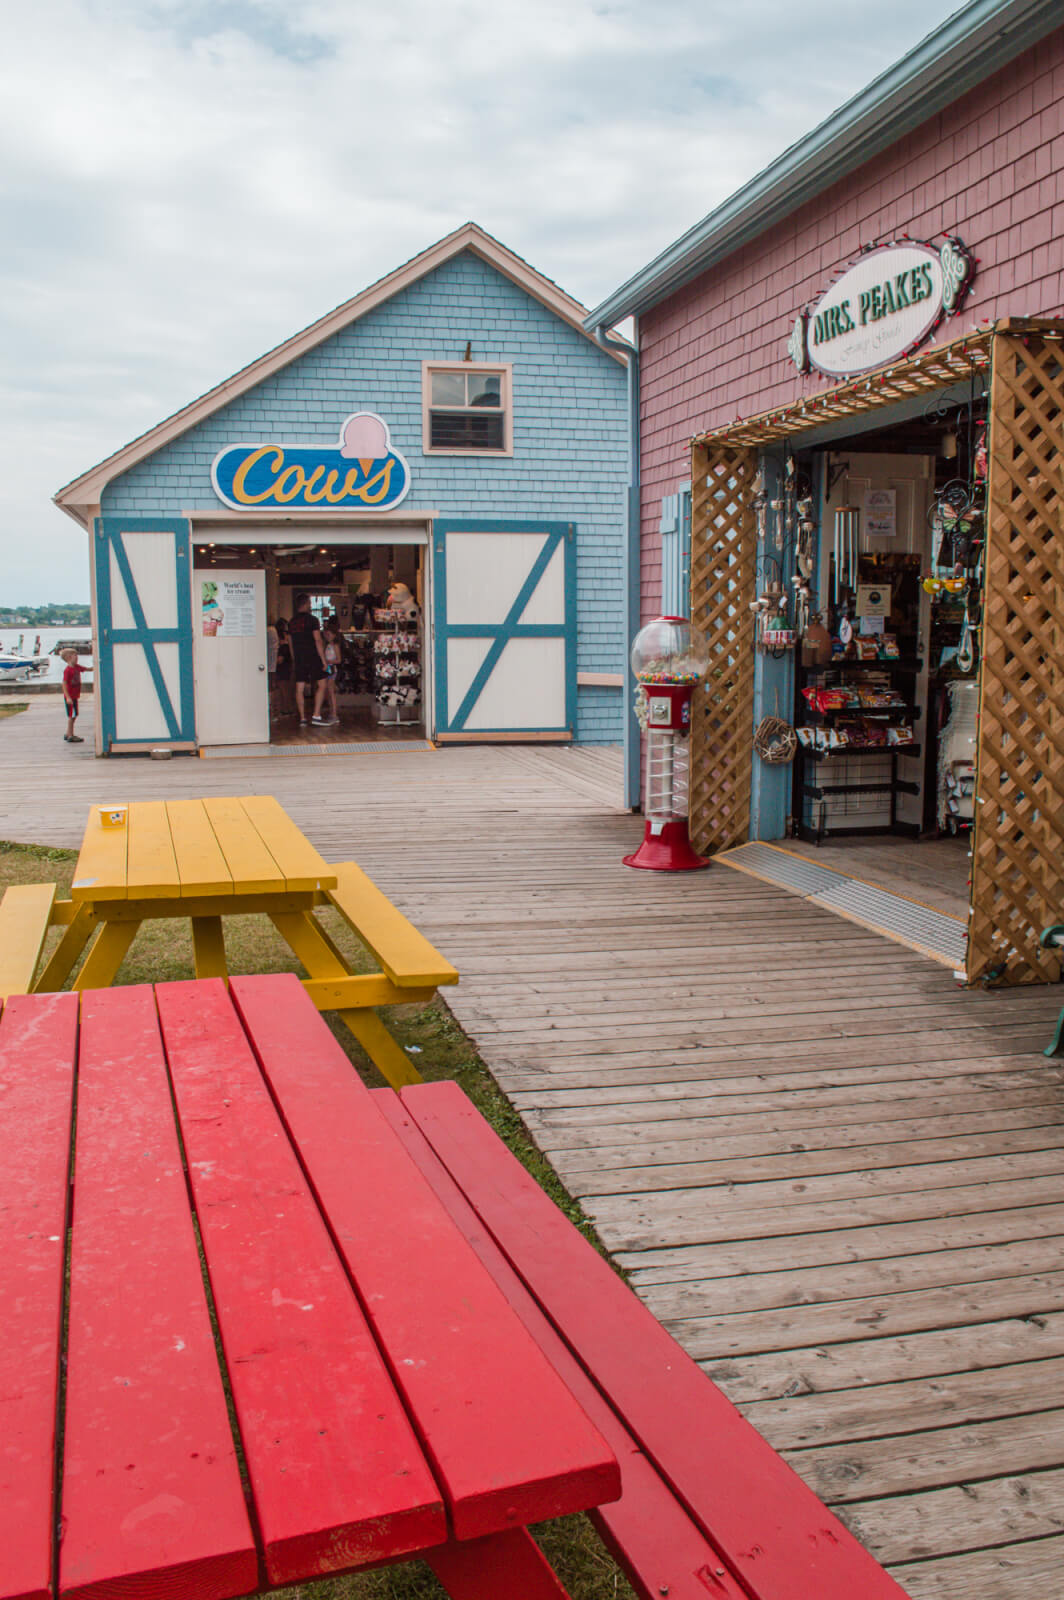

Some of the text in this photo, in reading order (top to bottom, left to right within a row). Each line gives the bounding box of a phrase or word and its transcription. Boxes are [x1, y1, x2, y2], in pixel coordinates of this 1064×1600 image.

[813, 300, 855, 346] MRS.
[858, 262, 933, 326] PEAKES
[232, 445, 395, 504] Cows
